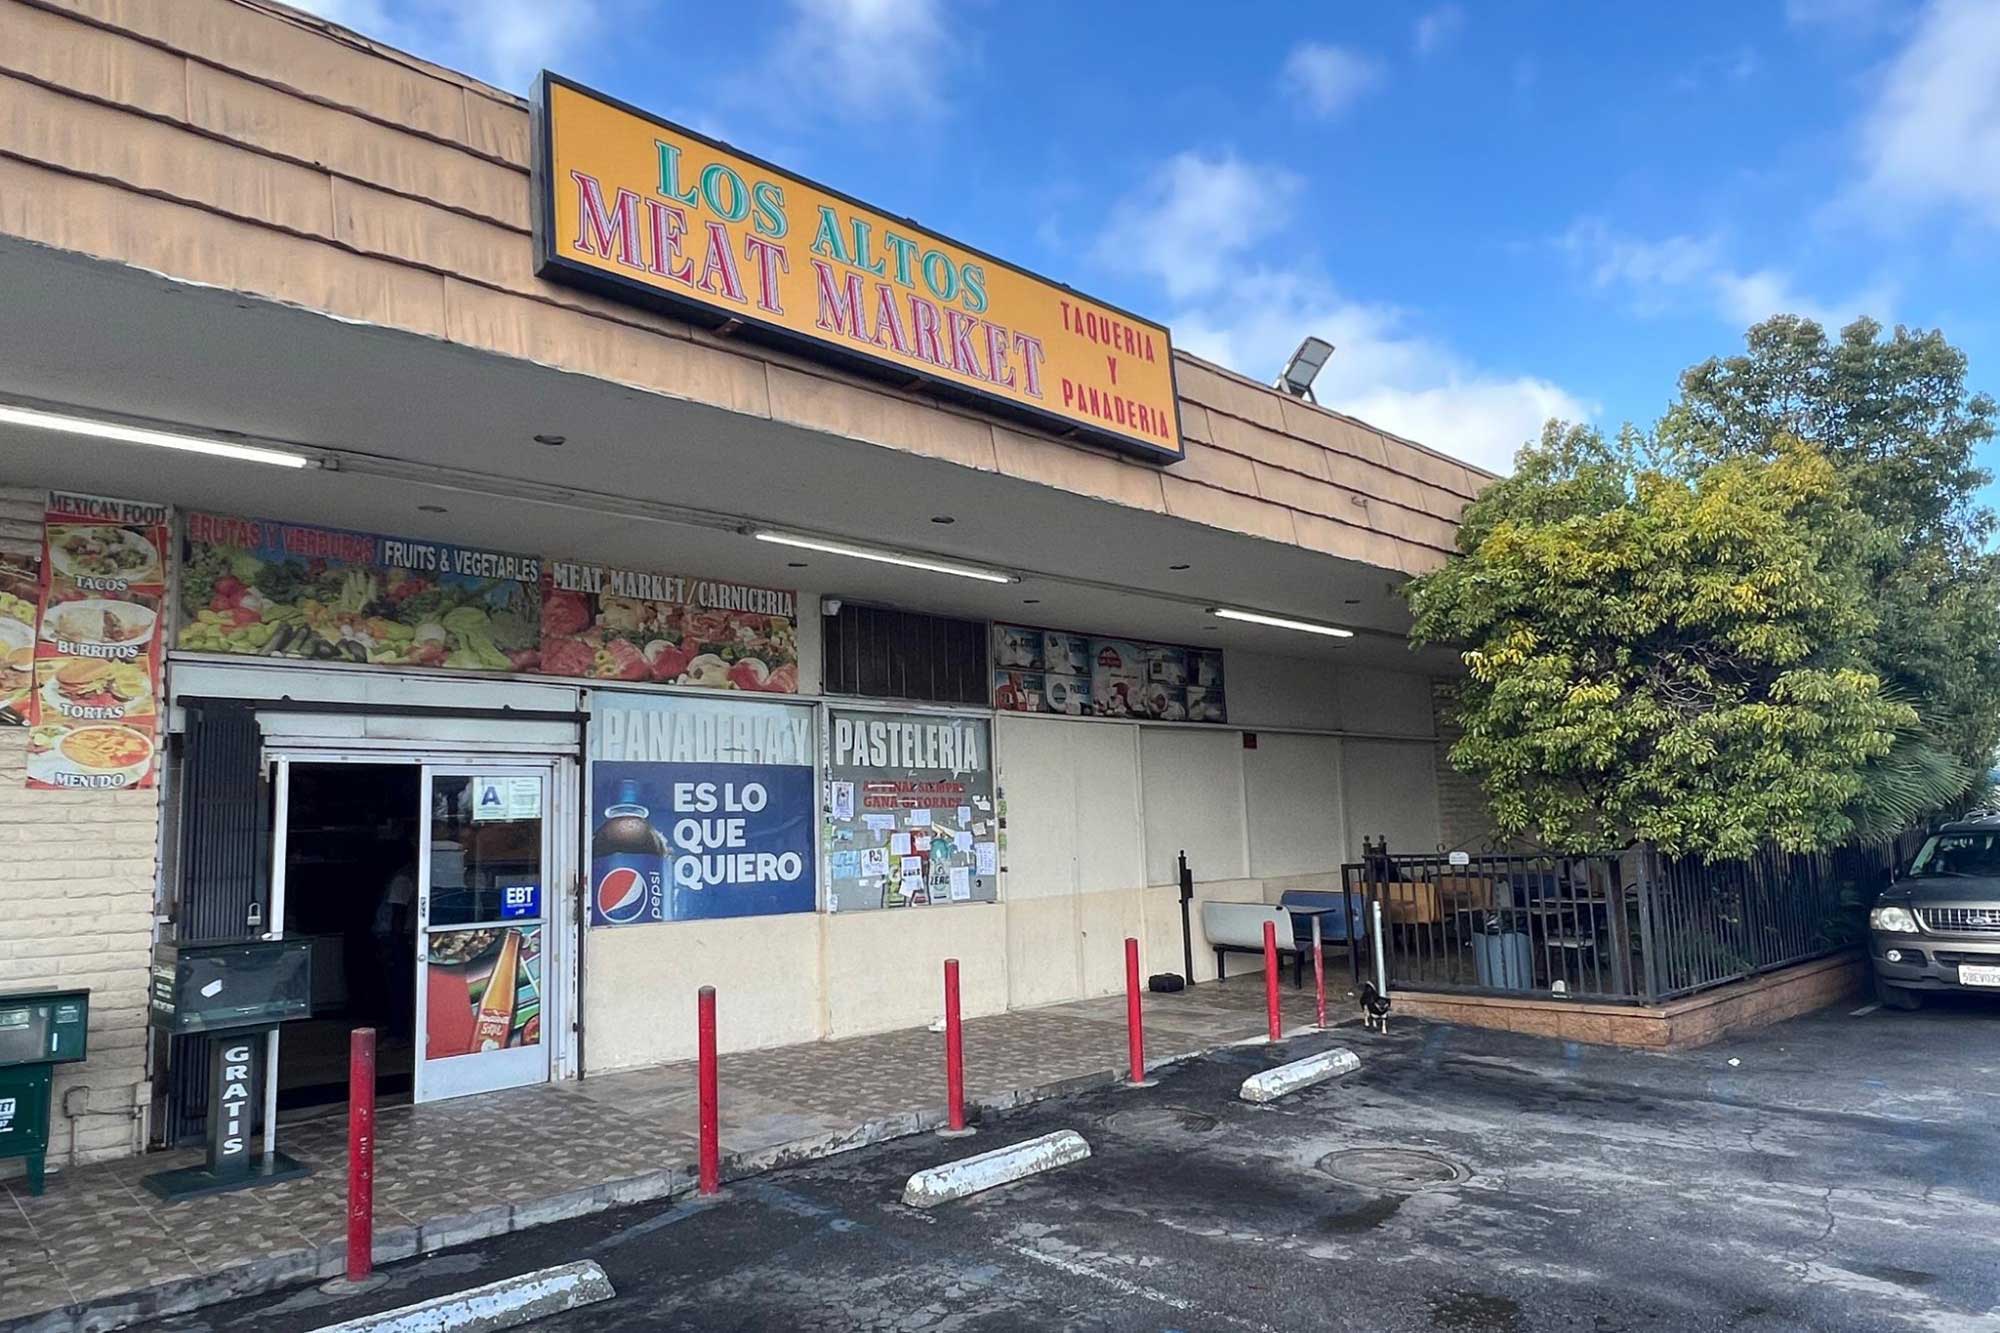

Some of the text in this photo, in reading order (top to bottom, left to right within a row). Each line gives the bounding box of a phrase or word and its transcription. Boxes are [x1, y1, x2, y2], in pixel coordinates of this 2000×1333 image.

[655, 138, 988, 314] LOS ALTOS
[570, 169, 1045, 400] MEAT MARKET
[1060, 301, 1155, 364] TAQUERIA
[1106, 355, 1118, 386] Y
[1062, 377, 1169, 440] PANADERIA
[49, 491, 167, 525] MEXICAN FOOD
[384, 541, 538, 583] FRUITS & VEGETABLES
[75, 574, 129, 592] TACOS
[552, 562, 603, 595] MEAT
[610, 569, 687, 605] MARKET
[699, 581, 794, 617] CARNICERIA
[58, 640, 139, 660] BURRITOS
[60, 702, 125, 720] TORTAS
[54, 772, 126, 788] MENUDO
[481, 786, 502, 806] A
[673, 782, 768, 813] ES LO
[673, 818, 746, 854] QUE
[673, 851, 802, 890] QUIERO
[507, 886, 534, 903] EBT
[651, 871, 663, 919] pepsi
[221, 1045, 250, 1156] GRATIS
